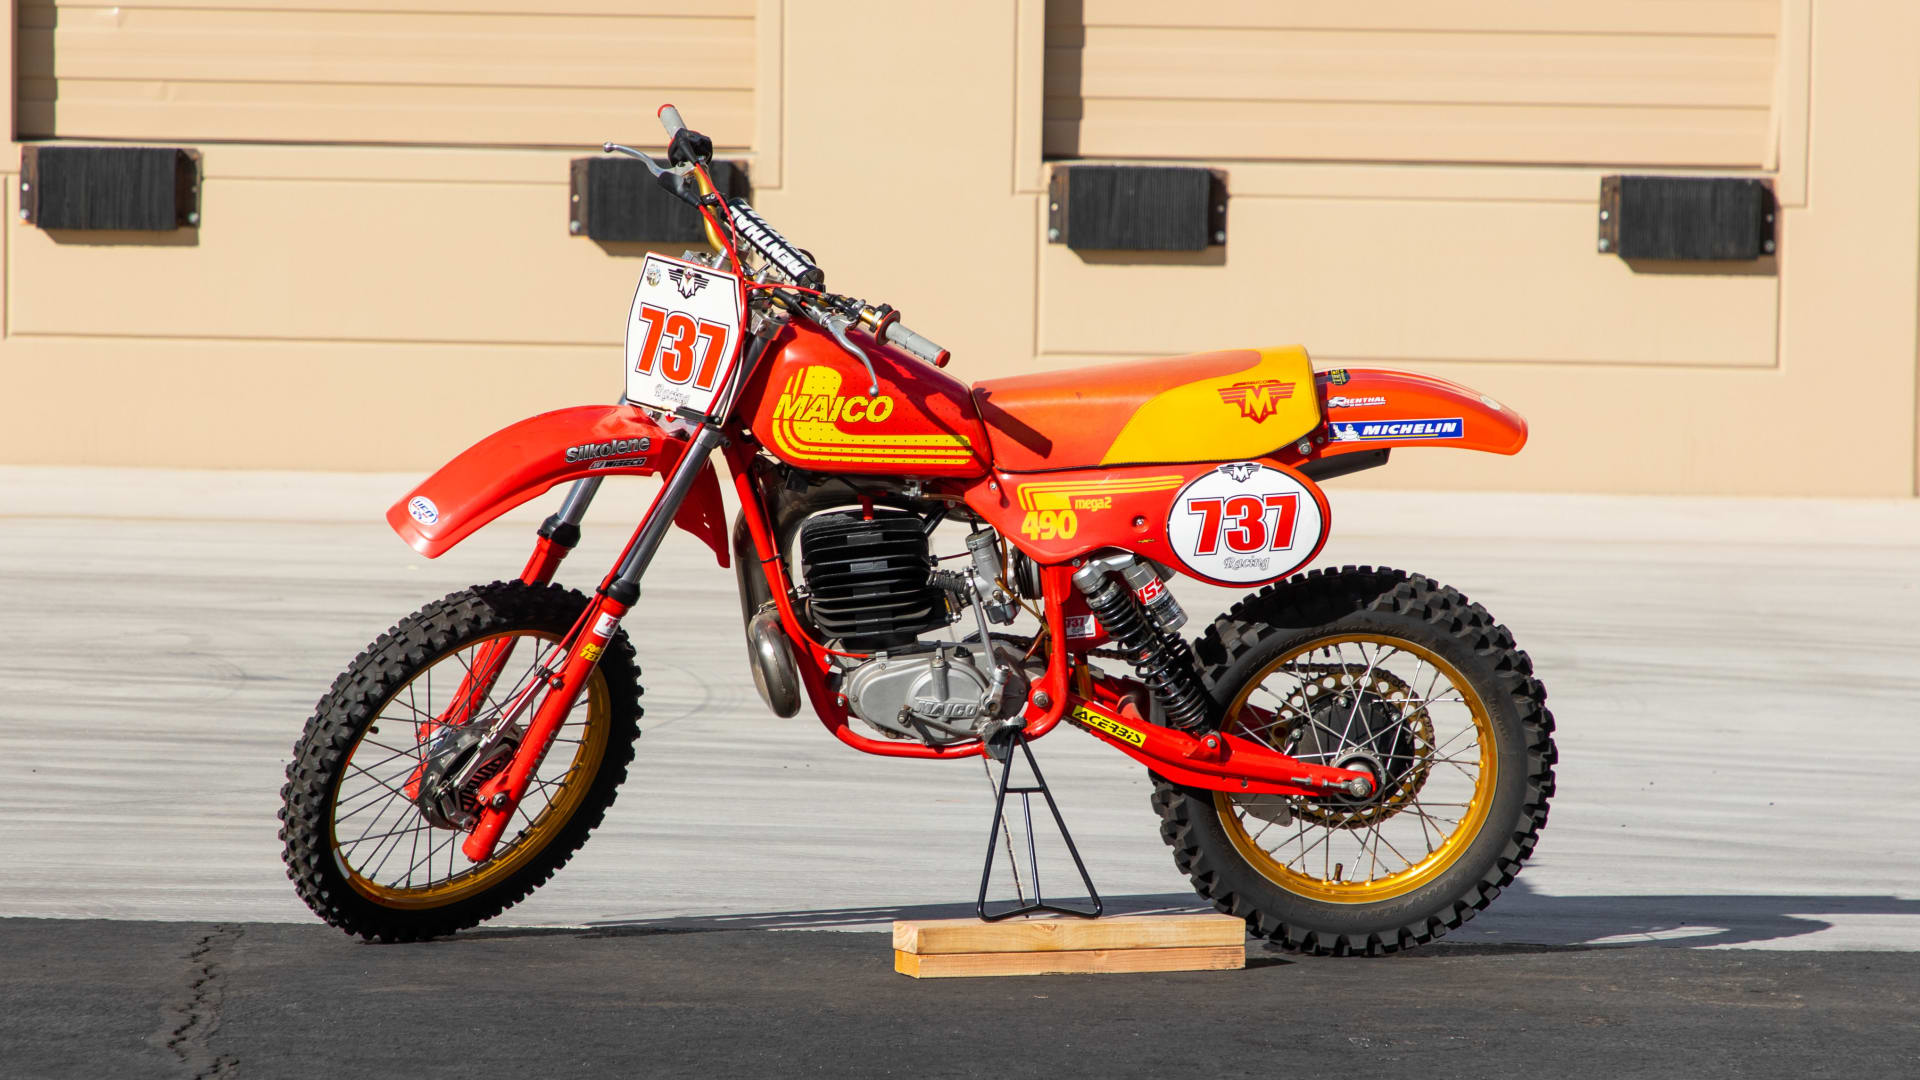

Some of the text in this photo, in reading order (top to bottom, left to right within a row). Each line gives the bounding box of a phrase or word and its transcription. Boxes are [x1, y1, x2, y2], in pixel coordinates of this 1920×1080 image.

[729, 205, 808, 277] RENTHAL
[635, 302, 731, 392] 737
[772, 393, 894, 423] MAICO
[1327, 396, 1386, 408] RENTHAL
[1362, 422, 1457, 436] MICHELIN
[565, 437, 650, 463] Silkolene
[1075, 496, 1112, 512] mega2
[1021, 510, 1078, 541] 490
[1187, 492, 1300, 556] 737
[1224, 555, 1270, 571] Racing
